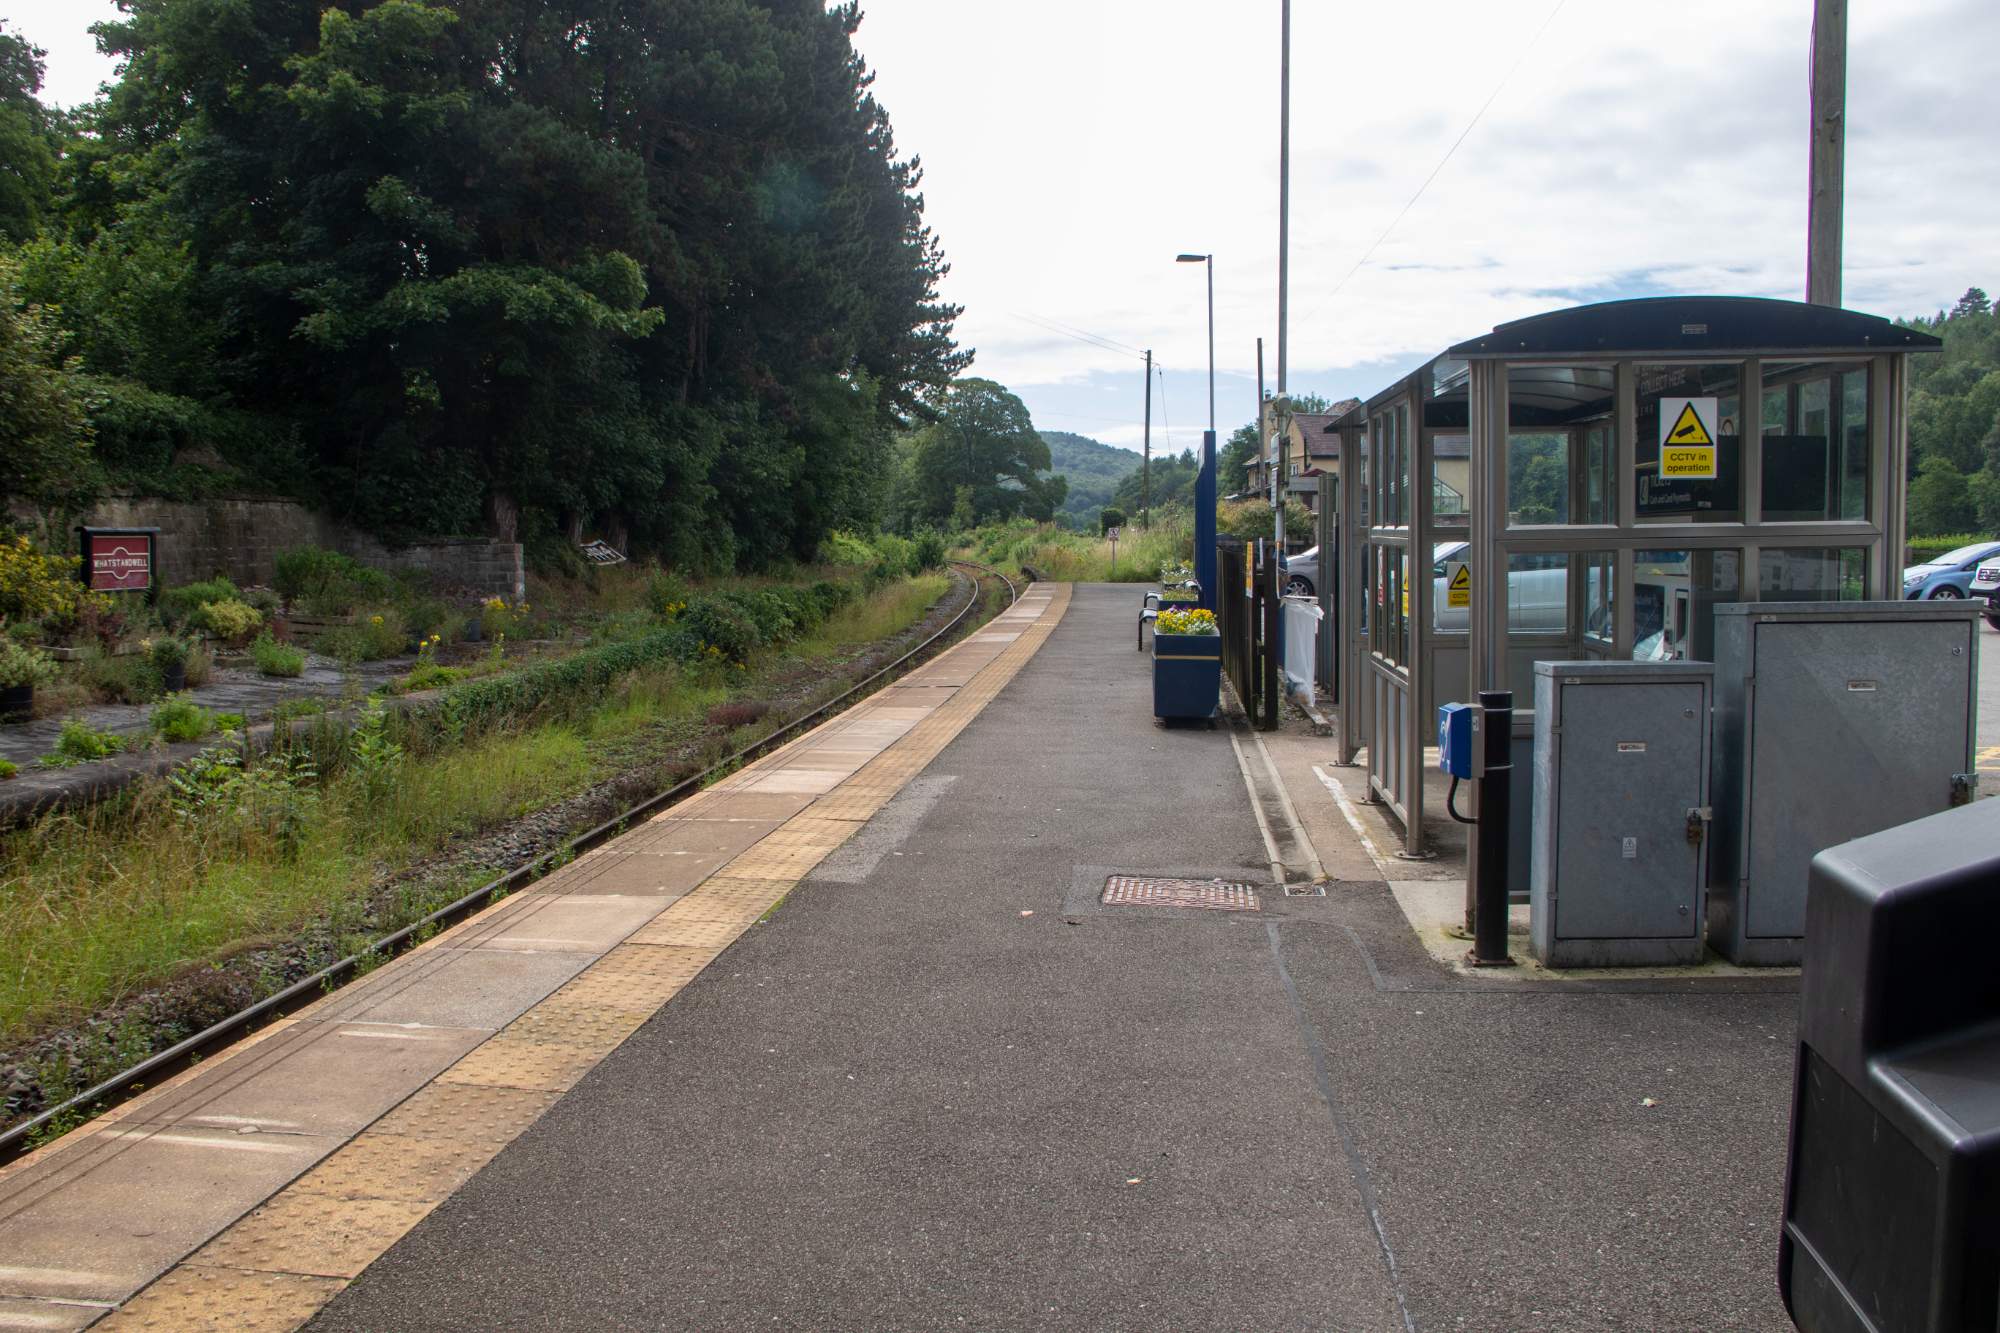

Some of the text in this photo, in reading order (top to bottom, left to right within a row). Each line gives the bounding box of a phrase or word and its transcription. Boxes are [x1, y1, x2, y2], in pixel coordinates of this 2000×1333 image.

[1670, 453, 1707, 461] CCTV in
[1667, 464, 1710, 474] operation
[93, 559, 147, 568] WHATSTANDWELL
